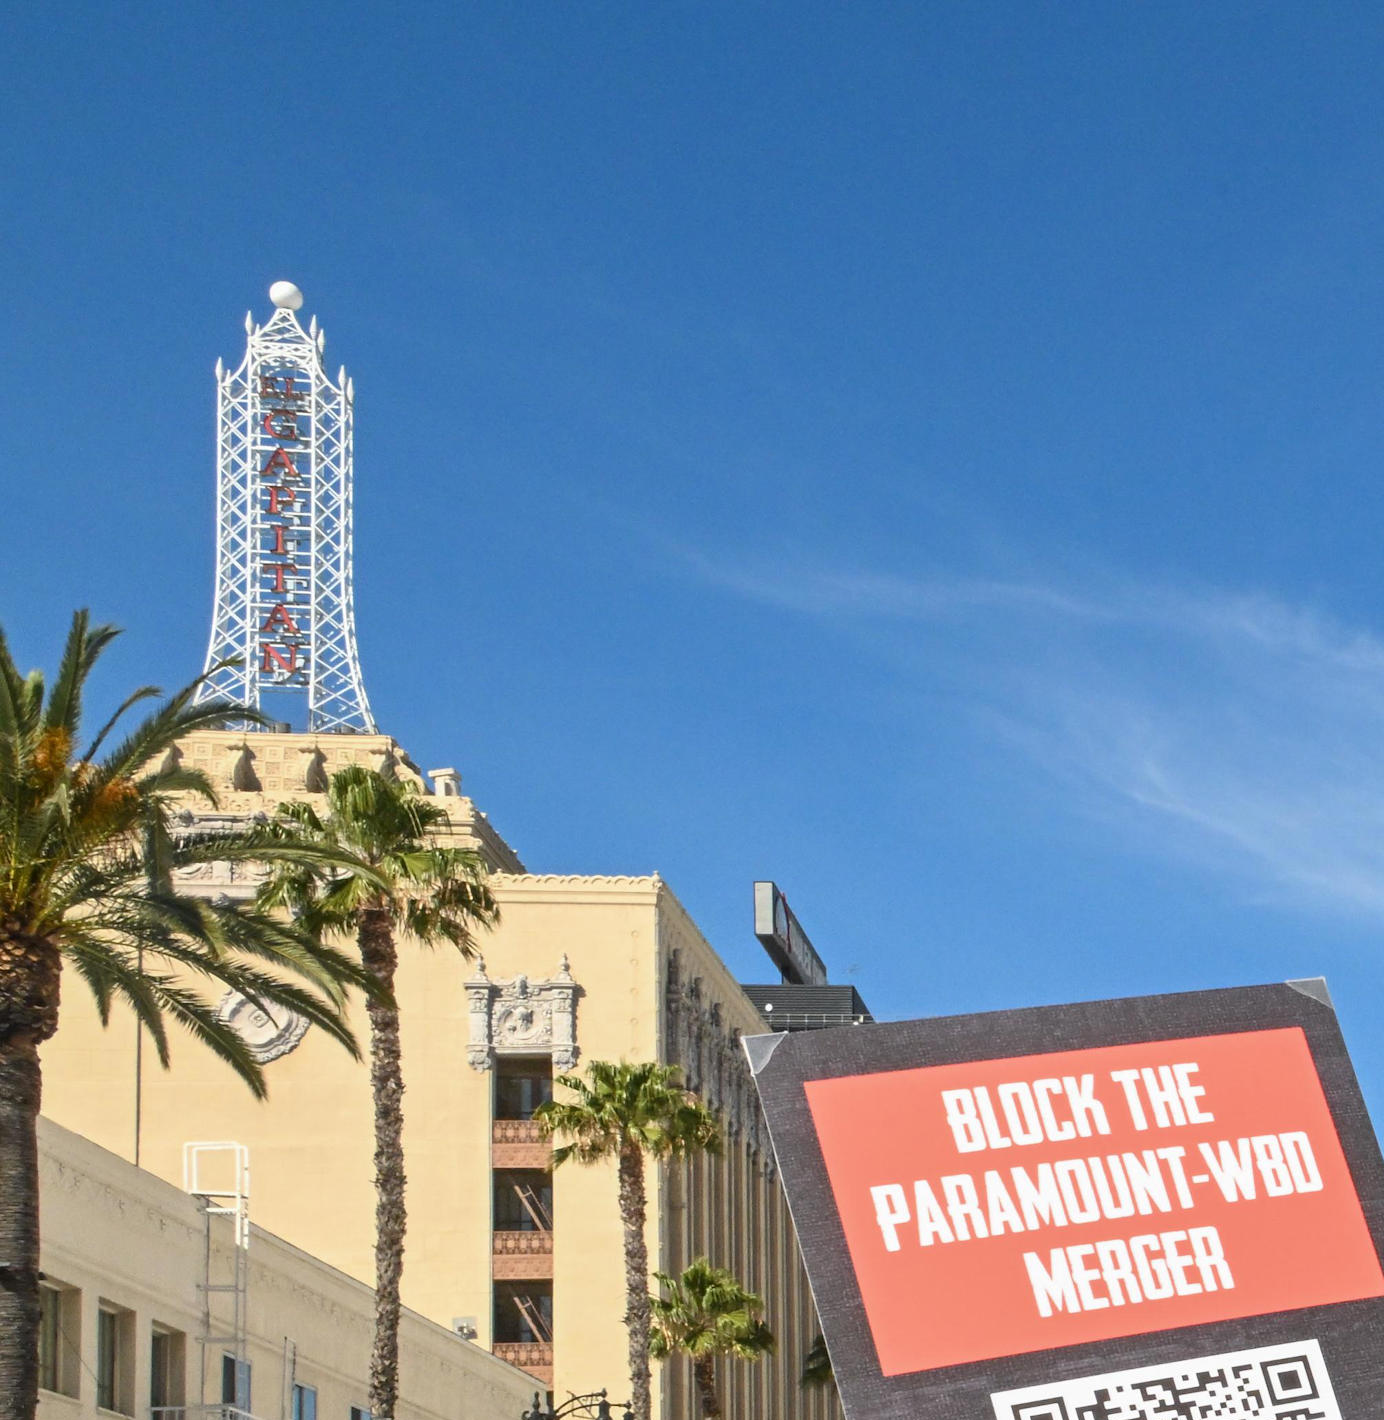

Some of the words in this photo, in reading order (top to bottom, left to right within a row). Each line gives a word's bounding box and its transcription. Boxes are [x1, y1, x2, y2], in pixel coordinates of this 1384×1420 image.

[941, 1073, 1110, 1153] BLOCK
[1110, 1062, 1215, 1131] THE
[869, 1131, 1324, 1252] PARAMOUNT-WBD
[1022, 1225, 1235, 1318] MERGER
